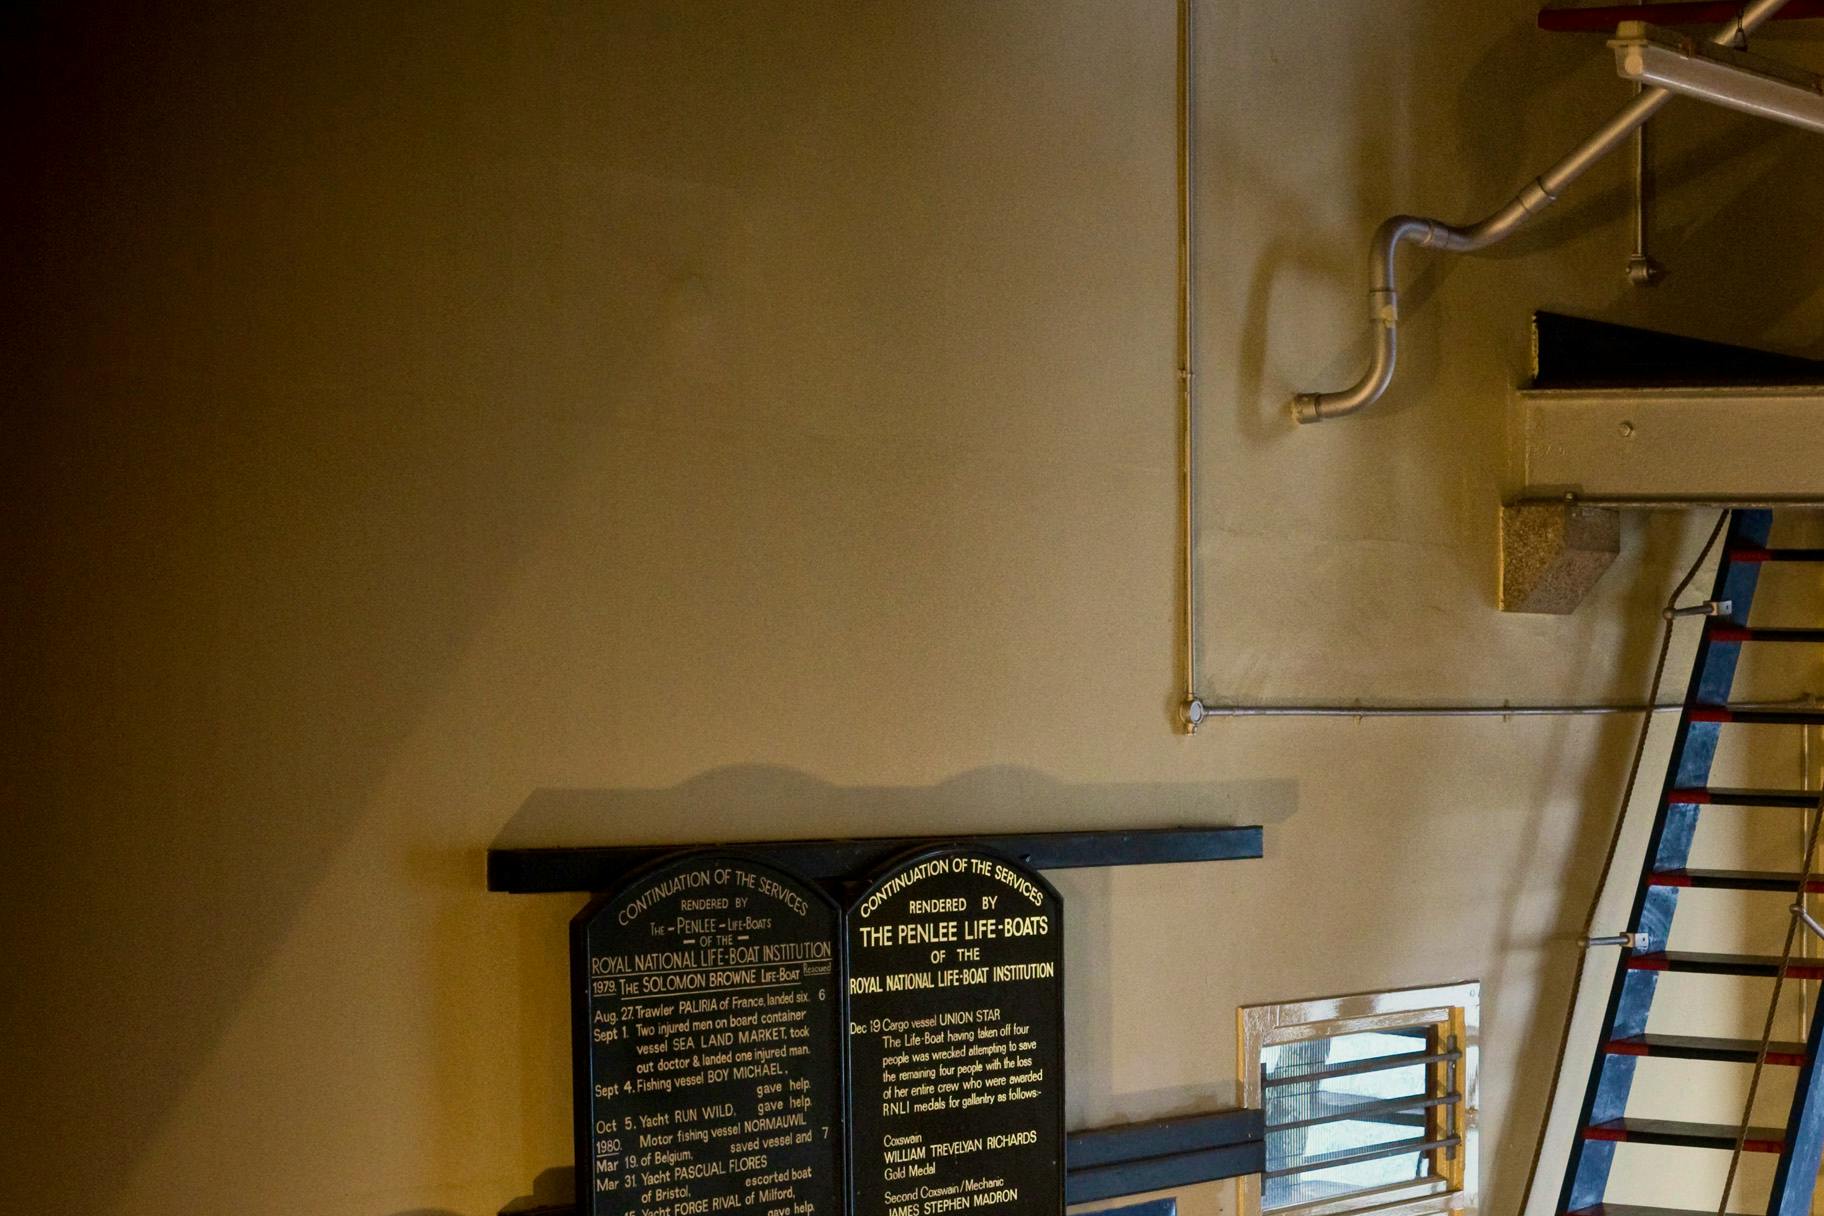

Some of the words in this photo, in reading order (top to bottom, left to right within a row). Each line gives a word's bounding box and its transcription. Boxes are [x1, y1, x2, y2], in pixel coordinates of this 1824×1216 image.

[618, 870, 710, 926] CONTINUATION
[715, 869, 731, 884] OF
[736, 871, 756, 888] THE
[759, 877, 808, 916] SERVICES
[861, 859, 949, 918] CONTINUATION
[952, 858, 968, 872] OF
[971, 859, 992, 876] THE
[995, 866, 1043, 906] SERVICES
[682, 899, 728, 911] RENDERED
[736, 899, 748, 908] BY
[909, 898, 966, 914] RENDERED
[982, 896, 998, 909] BY
[860, 926, 892, 947] THE
[898, 922, 957, 944] PENLEE
[965, 916, 1048, 940] LIFE-BOATS
[592, 956, 632, 974] ROYAL
[635, 952, 697, 971] NATIONAL
[701, 947, 758, 967] LIFE-BOAT
[764, 942, 831, 963] INSTITUTION
[931, 951, 946, 964] OF
[957, 948, 980, 961] THE
[643, 973, 706, 992] SOLOMON
[710, 970, 756, 986] BROWNE
[850, 977, 883, 995] ROYAL
[886, 972, 934, 991] NATIONAL
[938, 968, 989, 986] LIFE-BOAT
[994, 962, 1054, 982] INSTITUTION
[636, 1007, 674, 1019] Trawler
[679, 999, 717, 1014] PALIRIA
[730, 1014, 758, 1028] board
[761, 1010, 806, 1024] container
[939, 1012, 973, 1026] UNION
[976, 1009, 1000, 1021] STAR
[637, 1042, 668, 1054] vessel
[673, 1037, 694, 1050] SEA
[701, 1034, 733, 1048] LAND
[883, 1036, 901, 1048] The
[948, 1030, 974, 1042] having
[978, 1027, 998, 1038] taken
[658, 1057, 689, 1071] doctor
[702, 1051, 732, 1066] landed
[883, 1055, 909, 1068] people
[932, 1046, 965, 1060] wrecked
[637, 1077, 671, 1094] Fishing
[674, 1073, 704, 1085] vessel
[708, 1070, 729, 1083] BOY
[900, 1068, 935, 1081] remaining
[958, 1062, 983, 1077] people
[911, 1083, 934, 1096] entire
[938, 1082, 959, 1092] crew
[985, 1076, 1006, 1087] were
[1009, 1069, 1042, 1084] awarded
[914, 1098, 945, 1112] medals
[962, 1093, 995, 1109] gallantry
[640, 1113, 669, 1129] Yacht
[675, 1108, 697, 1122] RUN
[640, 1134, 673, 1149] Motor
[677, 1127, 708, 1145] fishing
[711, 1124, 741, 1137] vessel
[730, 1140, 759, 1152] saved
[762, 1135, 792, 1148] vessel
[884, 1133, 922, 1147] Coxswain
[884, 1147, 925, 1163] WILLIAM
[931, 1139, 982, 1157] TREVELYAN
[987, 1131, 1037, 1149] RICHARDS
[597, 1178, 619, 1191] Mar
[641, 1172, 670, 1188] Yacht
[674, 1161, 725, 1180] PASCUAL
[729, 1155, 767, 1173] FLORES
[745, 1170, 790, 1186] escorted
[885, 1167, 905, 1180] Gold
[909, 1162, 935, 1176] Medal
[674, 1199, 708, 1216] FORGE
[713, 1194, 741, 1210] RIVAL
[885, 1189, 918, 1204] Second
[924, 1197, 969, 1214] STEPHEN
[974, 1189, 1018, 1206] MADRON
